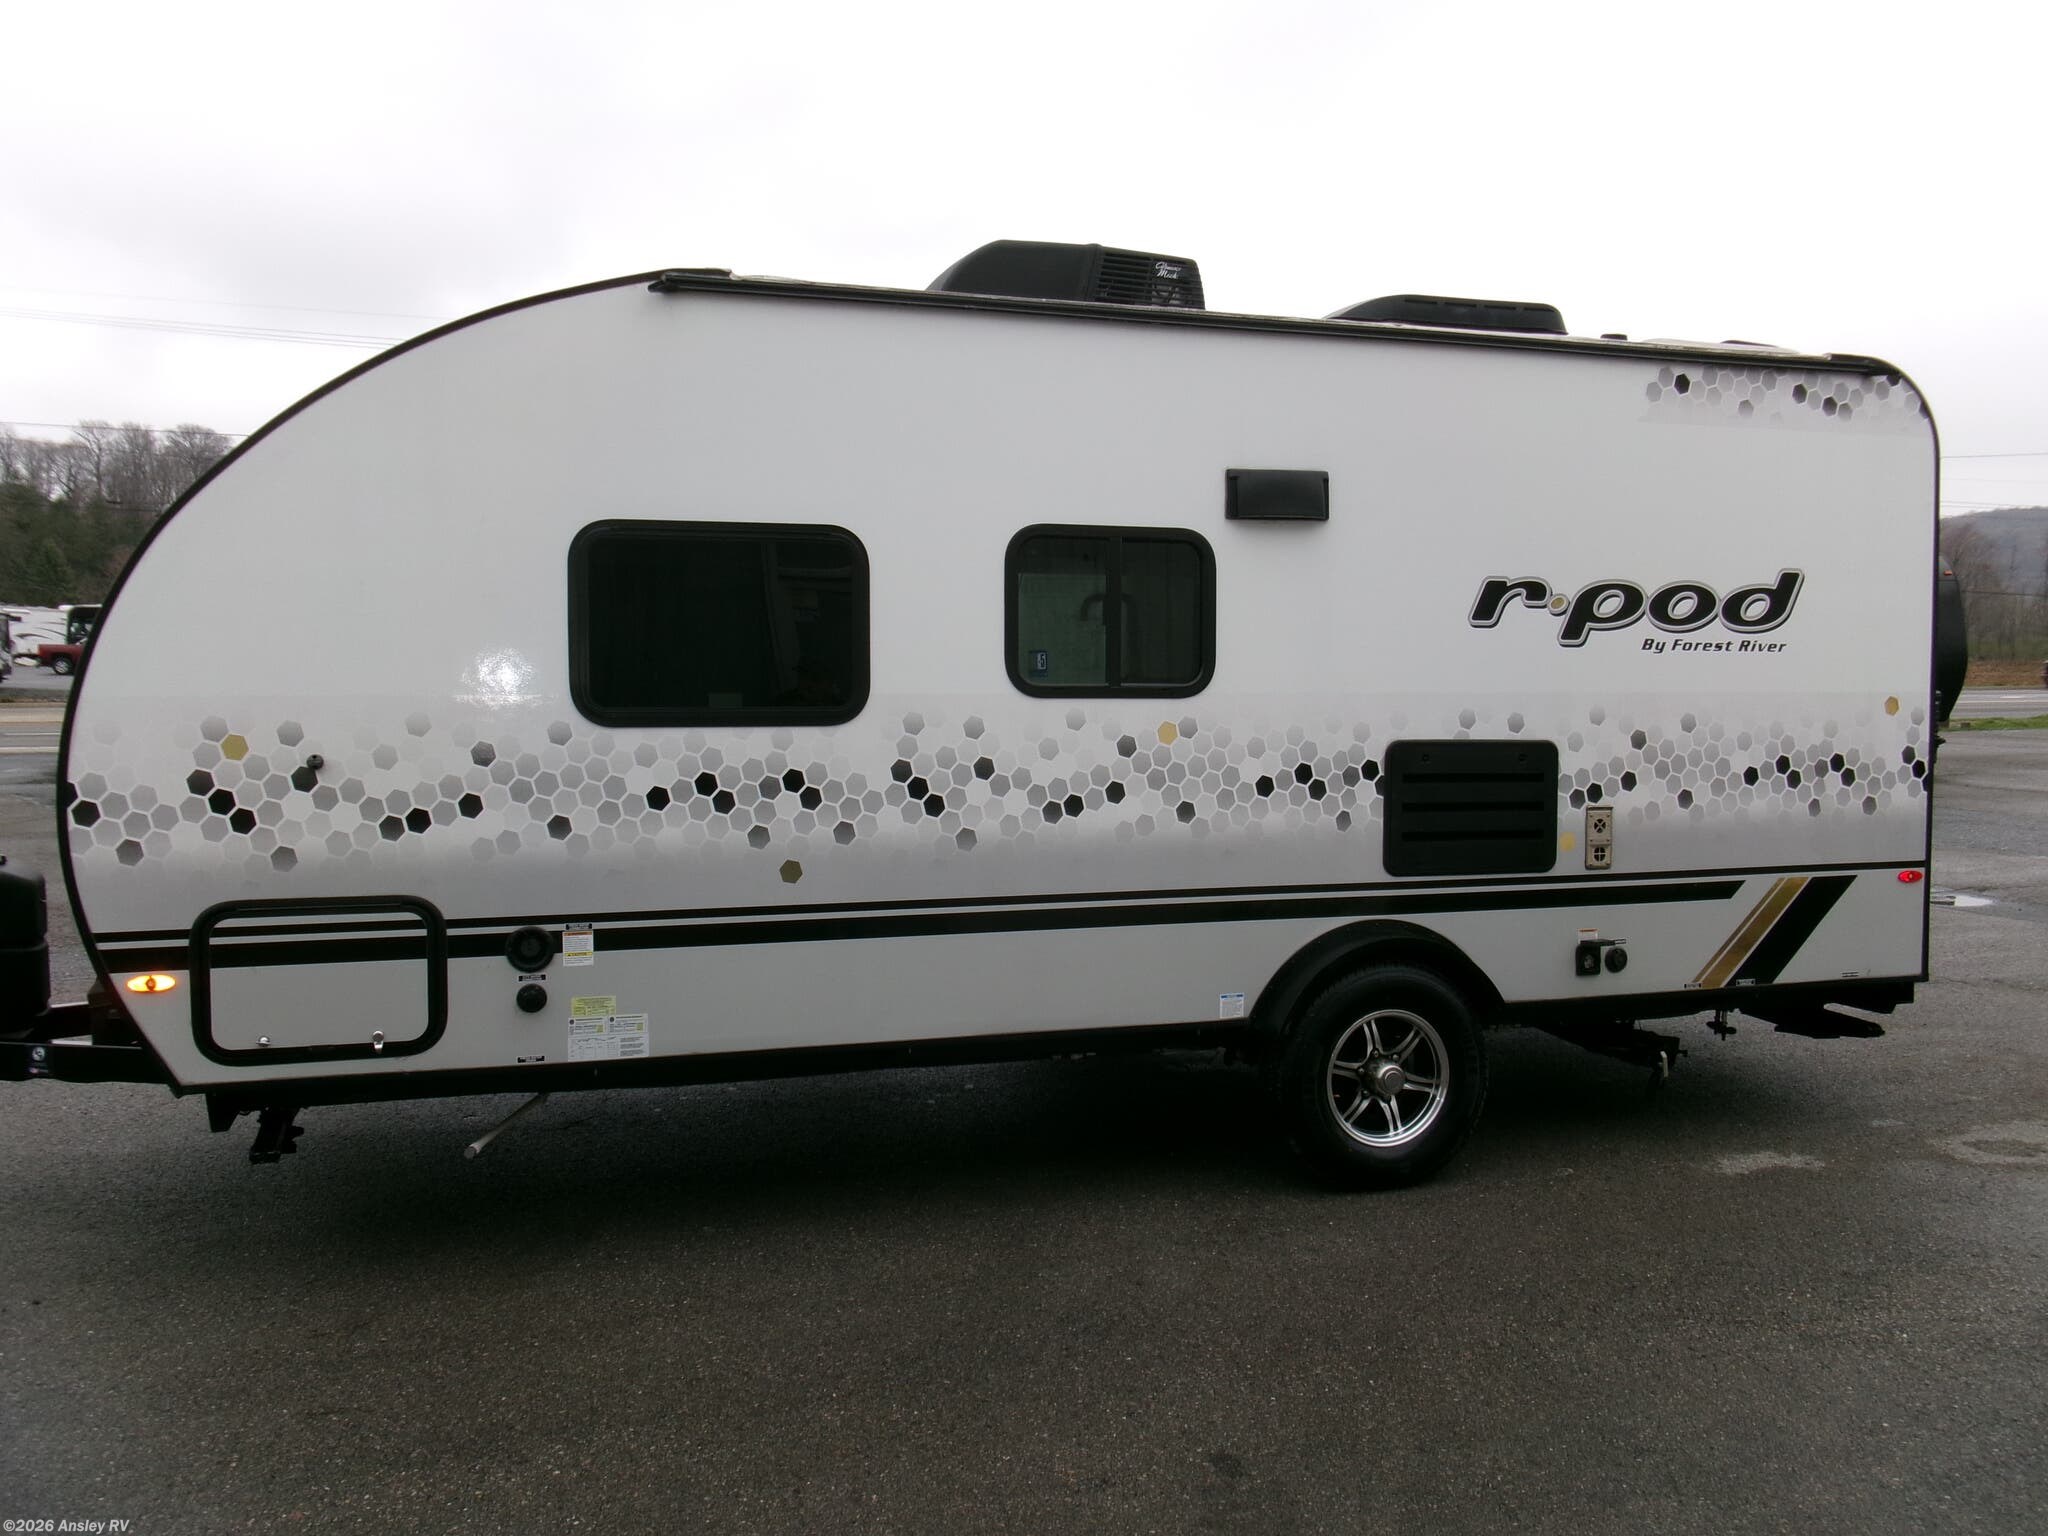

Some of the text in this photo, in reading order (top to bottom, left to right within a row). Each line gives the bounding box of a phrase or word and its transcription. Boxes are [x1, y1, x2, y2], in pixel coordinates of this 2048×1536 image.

[1641, 638, 1787, 654] By Forest River
